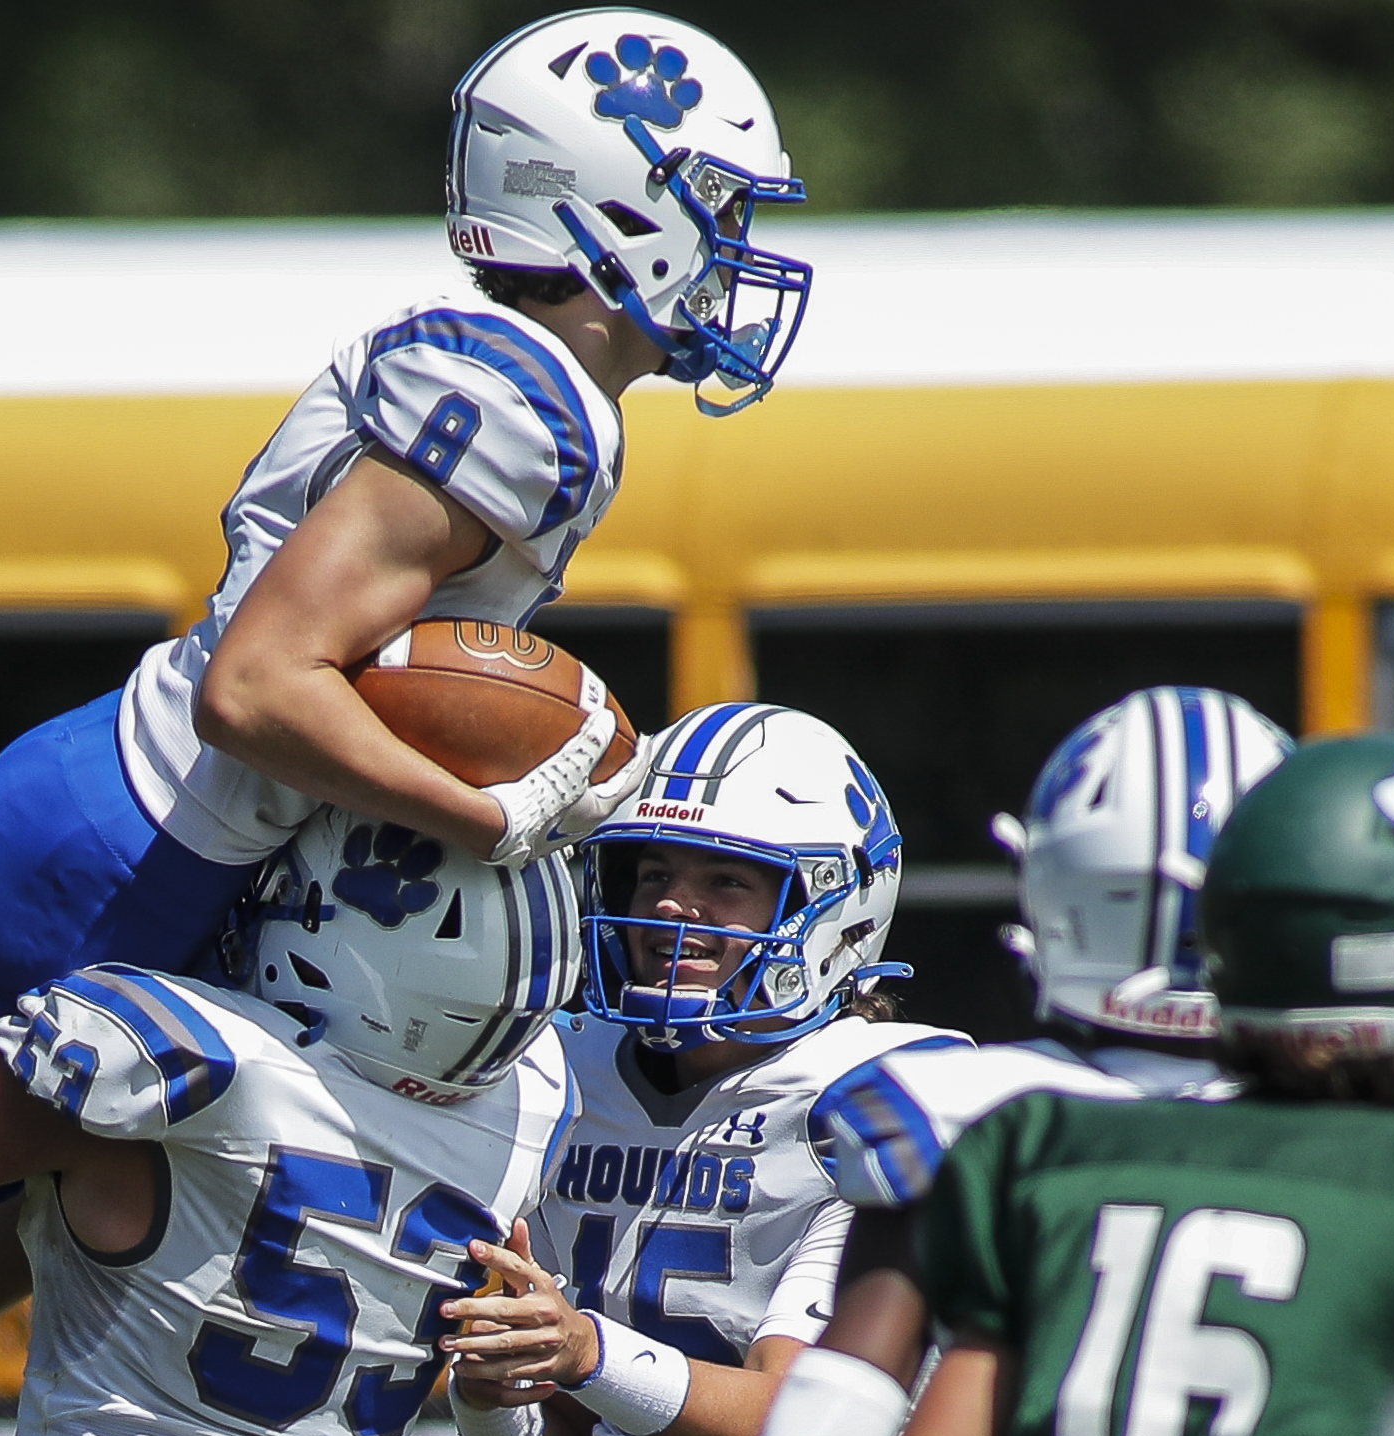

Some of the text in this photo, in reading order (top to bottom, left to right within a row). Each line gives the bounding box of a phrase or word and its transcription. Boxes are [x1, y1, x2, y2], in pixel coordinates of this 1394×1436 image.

[405, 390, 483, 487] 8
[636, 802, 705, 822] Riddell
[12, 1010, 101, 1117] 53
[557, 1143, 757, 1213] HOUNDS
[570, 1211, 745, 1366] 15
